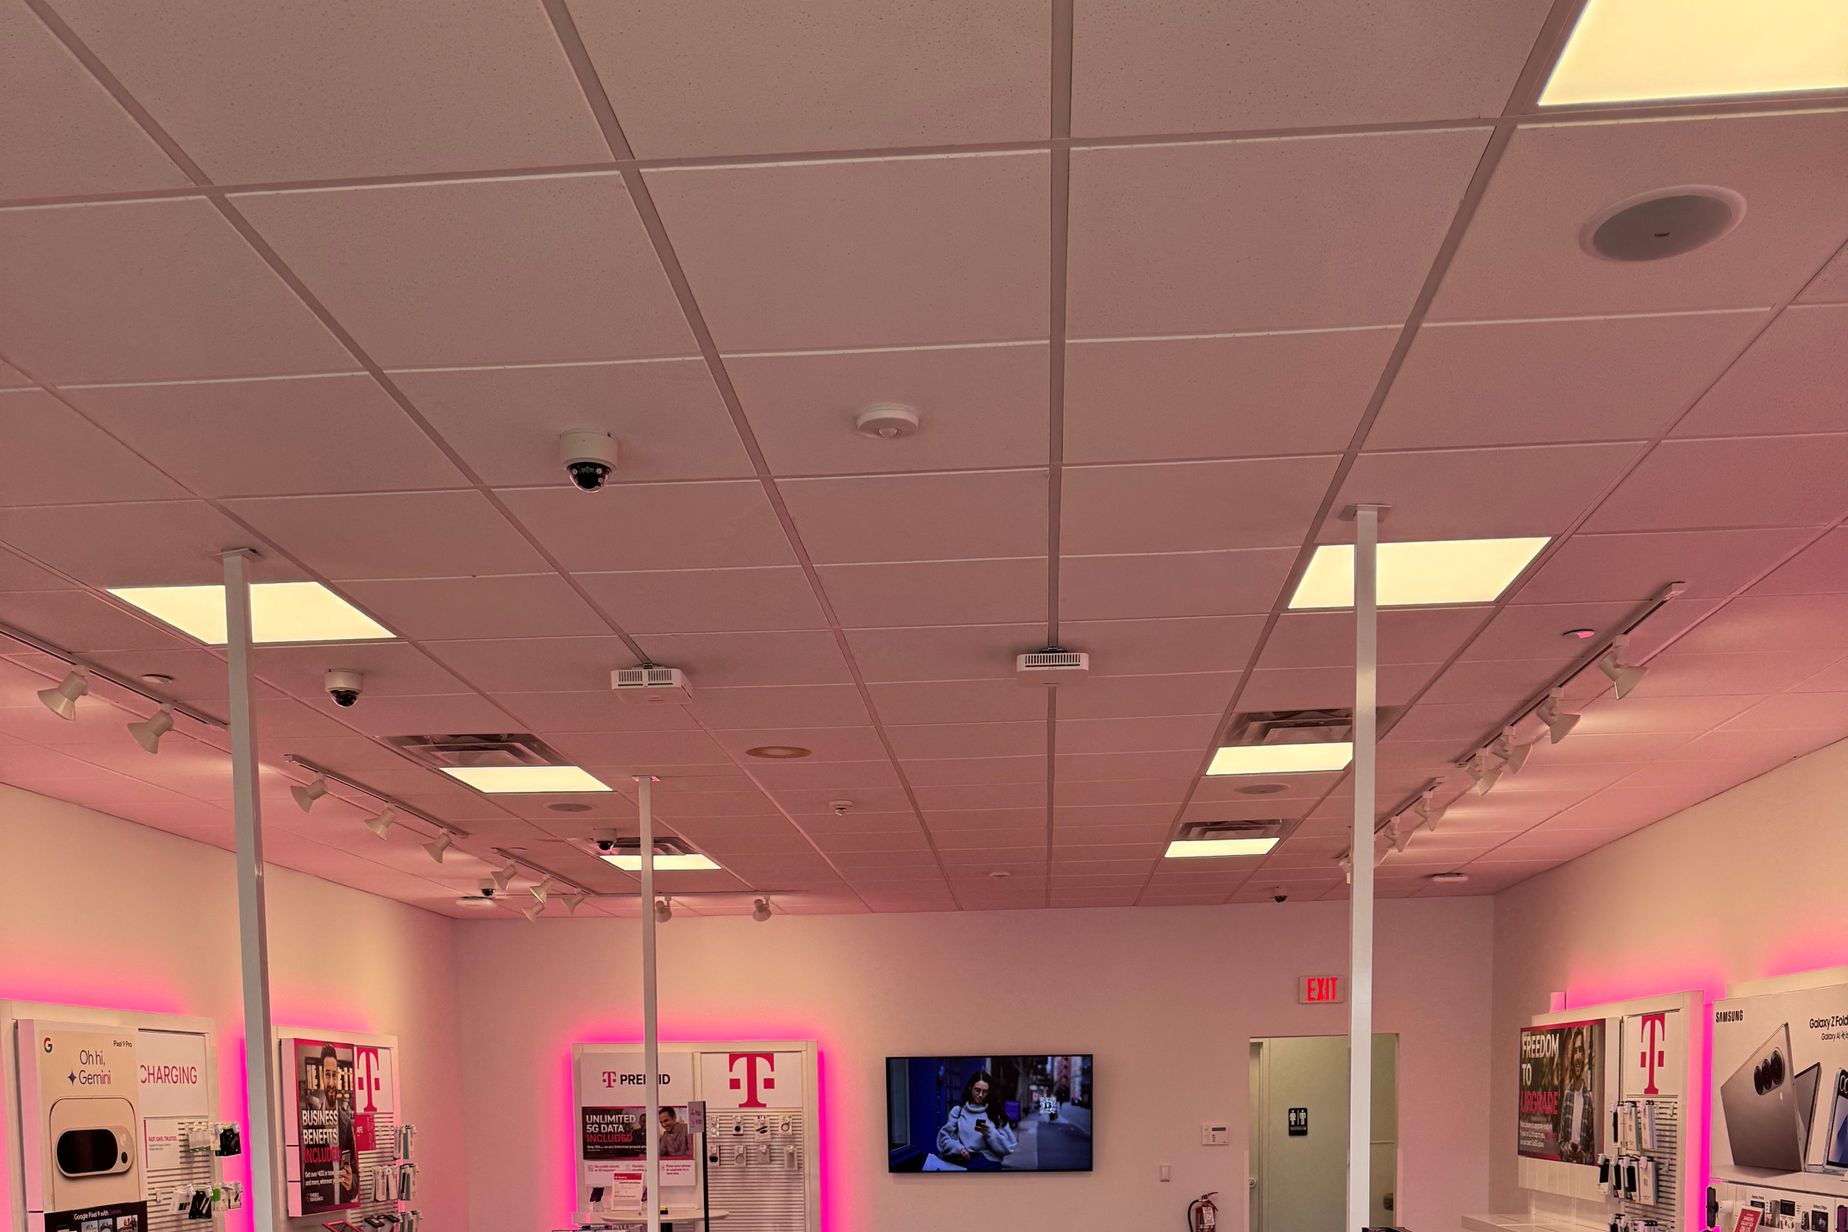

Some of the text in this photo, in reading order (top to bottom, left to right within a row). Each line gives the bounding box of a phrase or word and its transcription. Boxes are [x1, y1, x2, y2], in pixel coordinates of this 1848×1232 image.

[1307, 977, 1338, 1002] EXIT
[1715, 1010, 1744, 1023] SAMSUNG
[1809, 1017, 1831, 1030] Galaxy
[1831, 1016, 1835, 1026] Z
[1821, 1032, 1836, 1041] Galaxy
[1522, 1033, 1559, 1059] FREEDOM
[79, 1050, 106, 1066] Oh hi,
[78, 1069, 112, 1085] Gemini
[620, 1073, 671, 1085] PREID
[1522, 1063, 1533, 1087] TO
[1521, 1090, 1559, 1115] UPGRADE
[302, 1109, 339, 1126] BUSINESS
[586, 1114, 636, 1123] UNLIMITED
[586, 1124, 625, 1133] 5G DATA
[303, 1128, 338, 1145] BENEFITS
[586, 1133, 633, 1143] INCLUDED
[73, 1213, 88, 1221] Google
